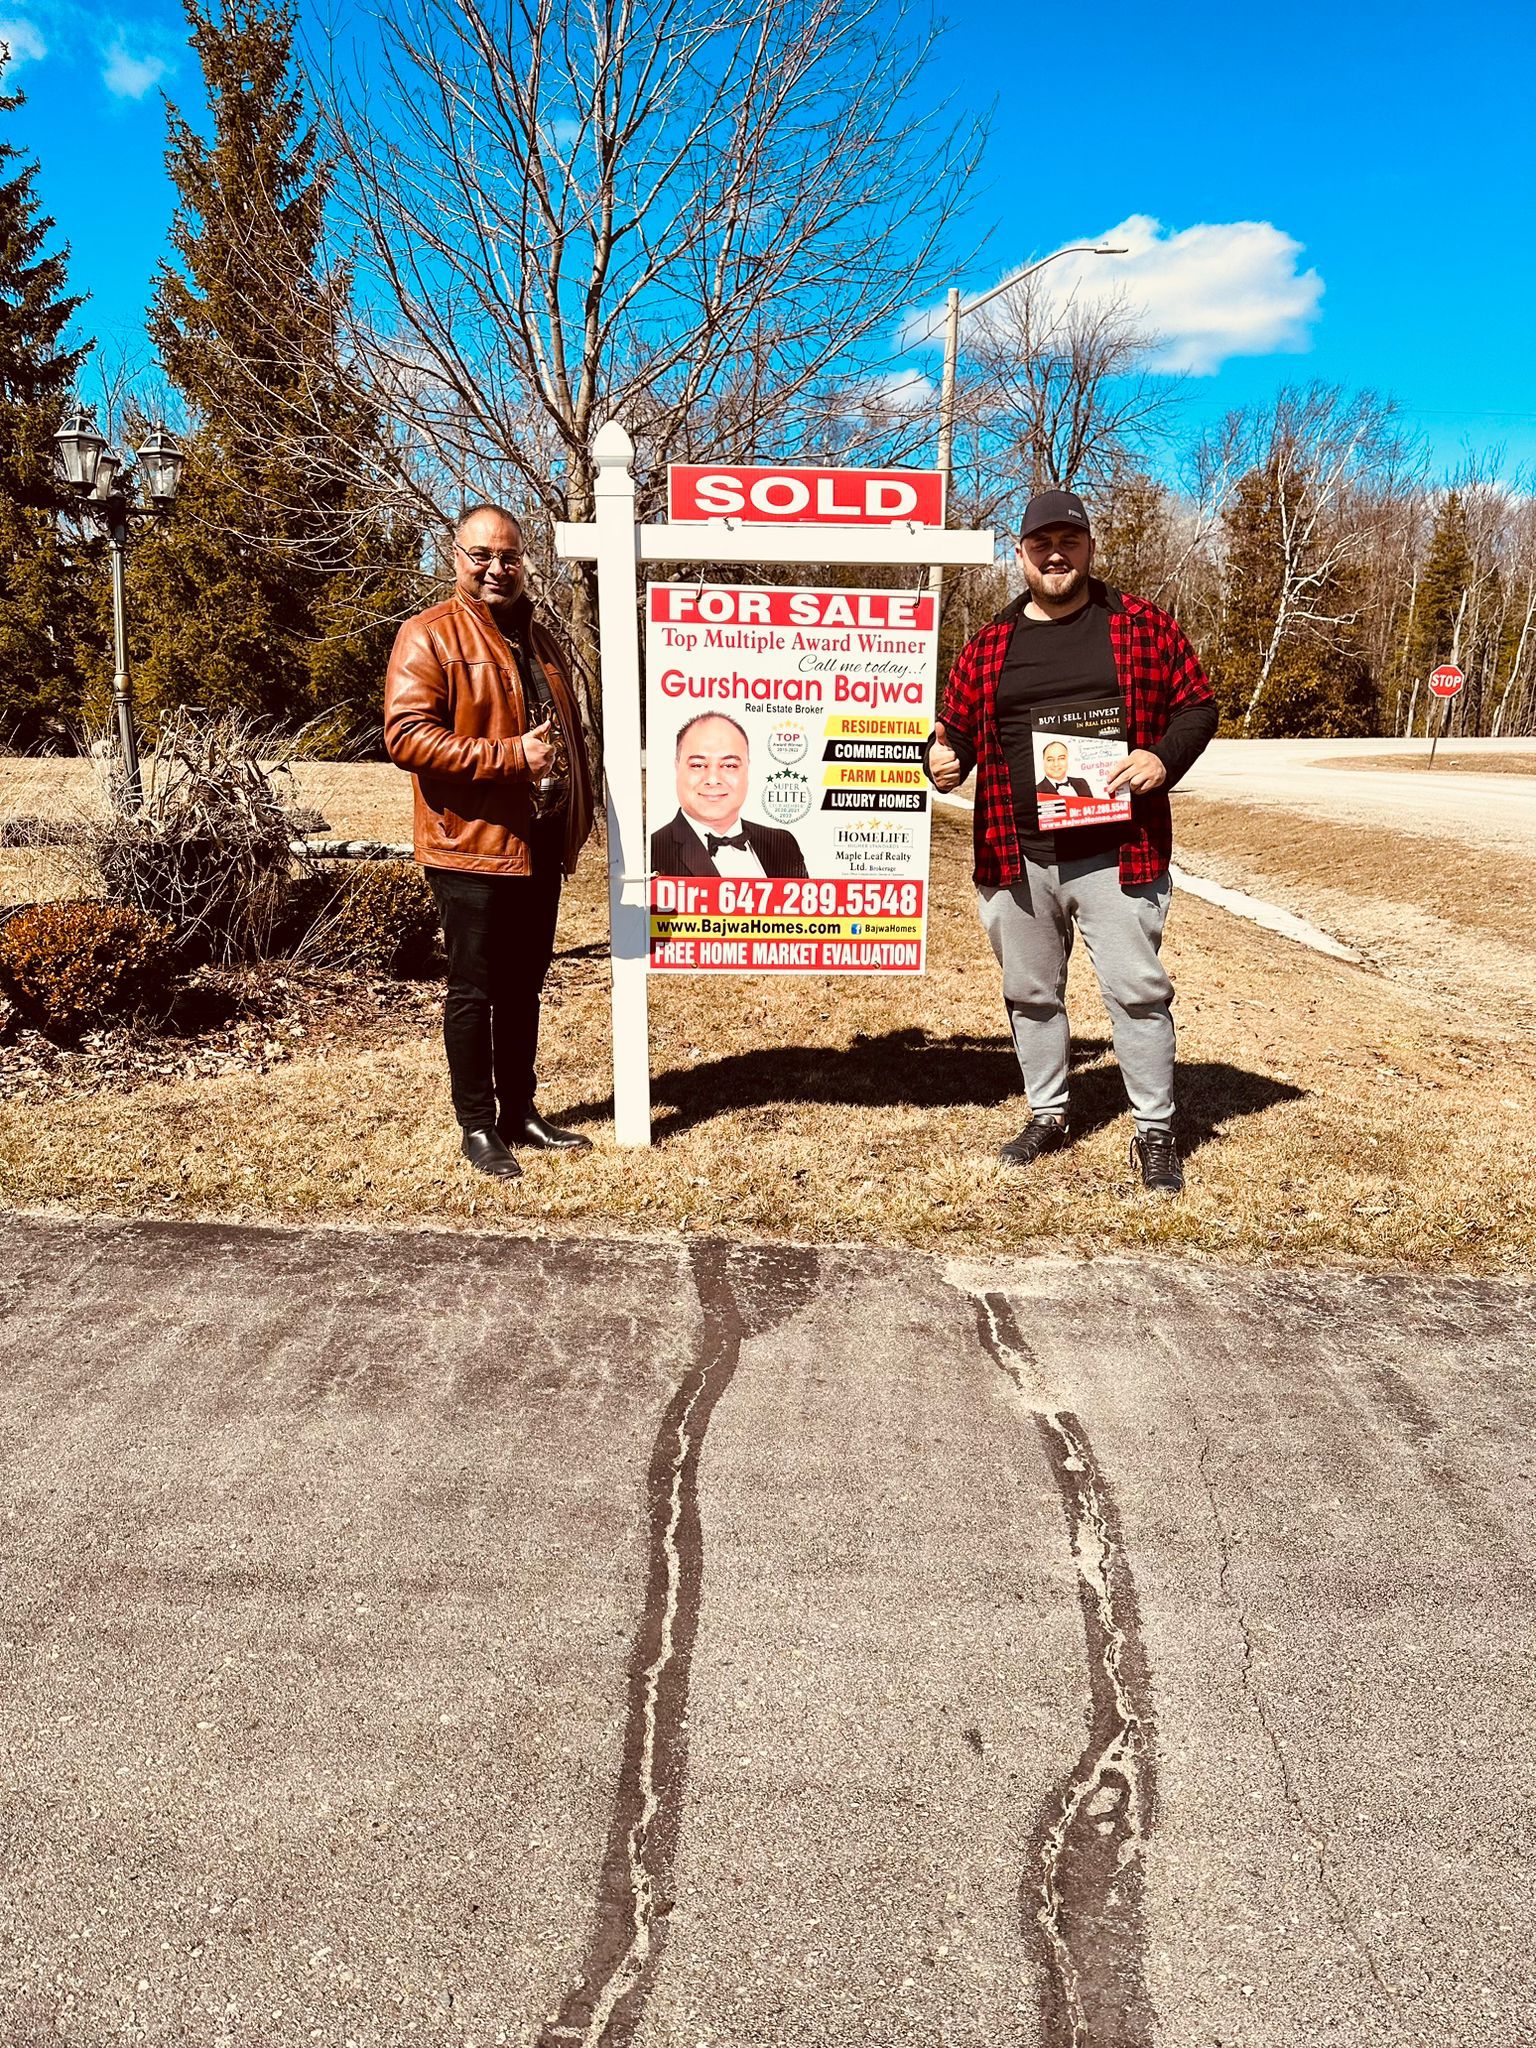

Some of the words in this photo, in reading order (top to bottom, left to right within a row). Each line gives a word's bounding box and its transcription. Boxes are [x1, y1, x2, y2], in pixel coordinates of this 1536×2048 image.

[694, 474, 918, 516] SOLD
[668, 589, 772, 624] FOR
[788, 593, 917, 628] SALE
[661, 627, 698, 649] Top
[703, 629, 786, 653] Multiple
[791, 632, 851, 652] Award
[857, 633, 926, 654] Winner
[797, 654, 838, 674] Call
[839, 662, 863, 673] me
[660, 668, 823, 700] Gursharan
[833, 674, 924, 708] Bajwa
[1431, 674, 1462, 688] STOP
[744, 702, 765, 713] Real
[766, 703, 794, 714] Estate
[795, 704, 824, 715] Broker
[1038, 716, 1056, 725] BUY
[1062, 712, 1082, 722] SELL
[1088, 707, 1120, 718] INVEST
[841, 719, 923, 735] RESIDENTIAL
[776, 733, 800, 742] TOP
[834, 744, 922, 760] COMMERCIAL
[840, 769, 877, 784] FARM
[880, 769, 921, 784] LANDS
[773, 782, 800, 790] SUPER
[768, 791, 807, 803] ELITE
[831, 793, 877, 808] LUXURY
[878, 794, 920, 809] HOMES
[835, 850, 862, 862] Maple
[864, 852, 884, 860] Leaf
[885, 852, 911, 862] Realty
[850, 862, 868, 871] Ltd.
[656, 881, 709, 914] Dir:
[717, 882, 917, 917] 647.289.5548
[656, 918, 842, 937] www.BajwaHomes.com
[864, 924, 917, 934] BajwaHomes
[654, 942, 695, 965] FREE
[700, 942, 748, 965] HOME
[752, 943, 819, 966] MARKET
[822, 943, 917, 967] EVALUATION
